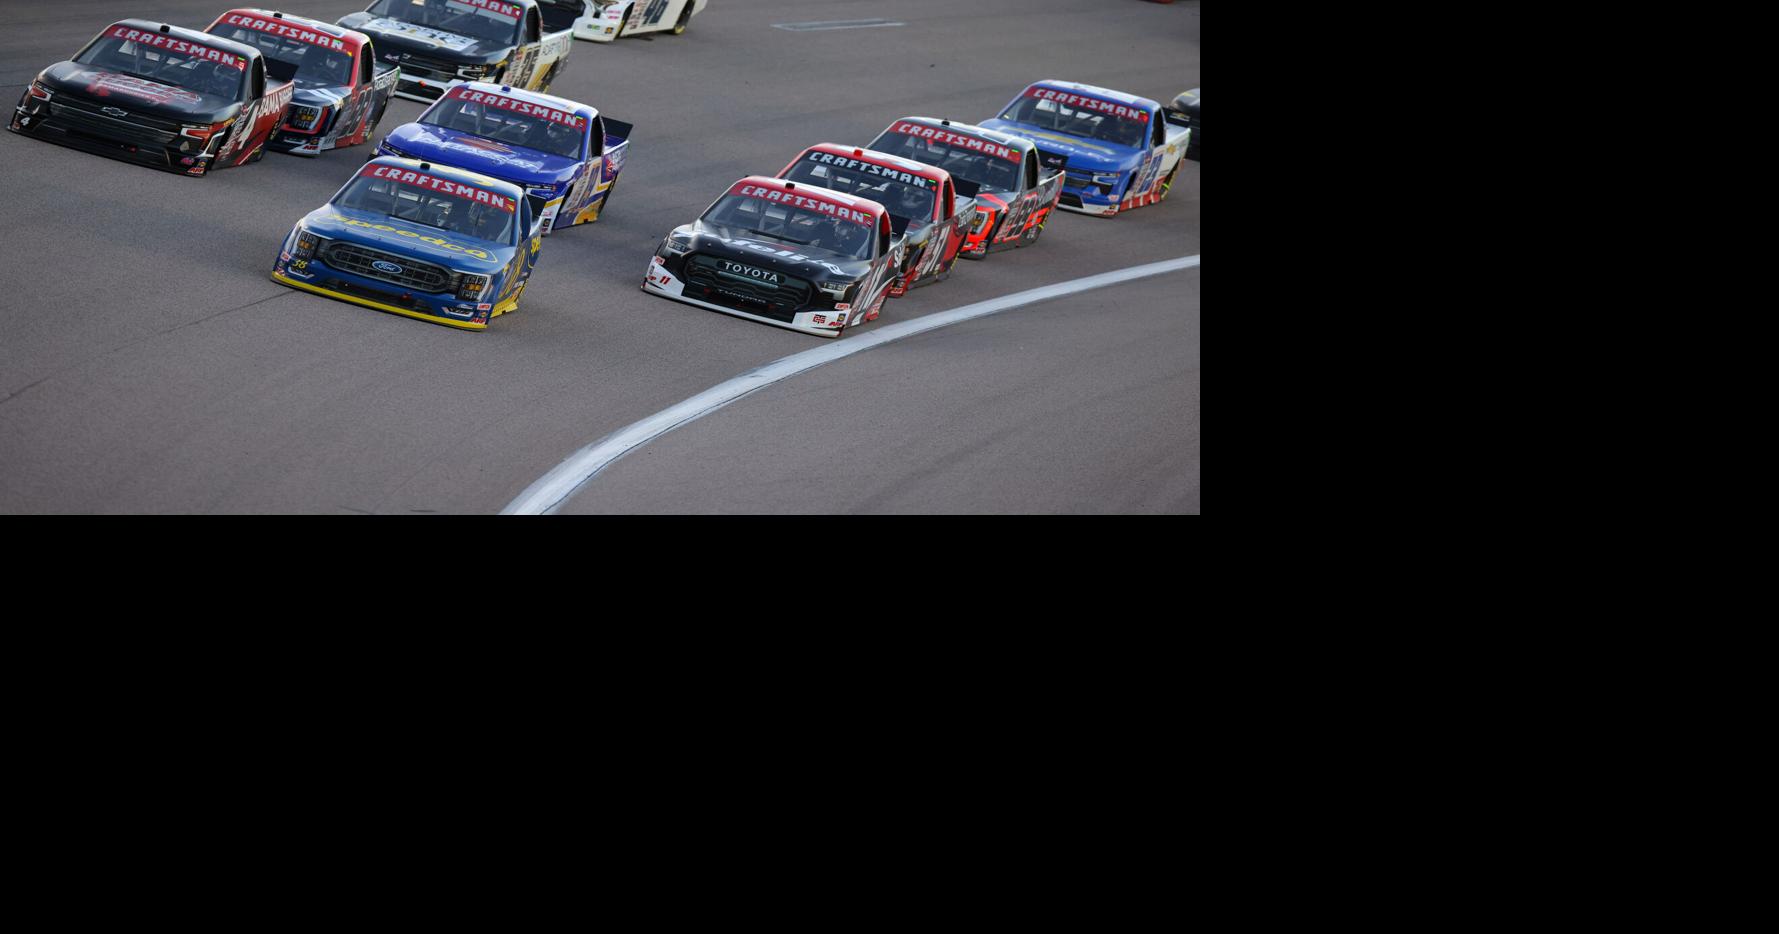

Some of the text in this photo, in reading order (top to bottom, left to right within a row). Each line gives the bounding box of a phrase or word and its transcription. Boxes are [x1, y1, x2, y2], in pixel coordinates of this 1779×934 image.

[114, 27, 234, 65] CRAFTSMAN
[228, 14, 344, 50] CRAFTSMAN
[20, 116, 31, 127] 4
[458, 89, 577, 127] CRAFTSMAN
[1033, 88, 1139, 120] CRAFTSMAN
[899, 123, 1009, 158] CRAFTSMAN
[373, 166, 504, 207] CRAFTSMAN
[809, 151, 927, 188] CRAFTSMAN
[740, 185, 864, 224] CRAFTSMAN
[376, 262, 398, 273] Ford
[659, 275, 671, 285] 11
[724, 261, 778, 283] TOYOTA
